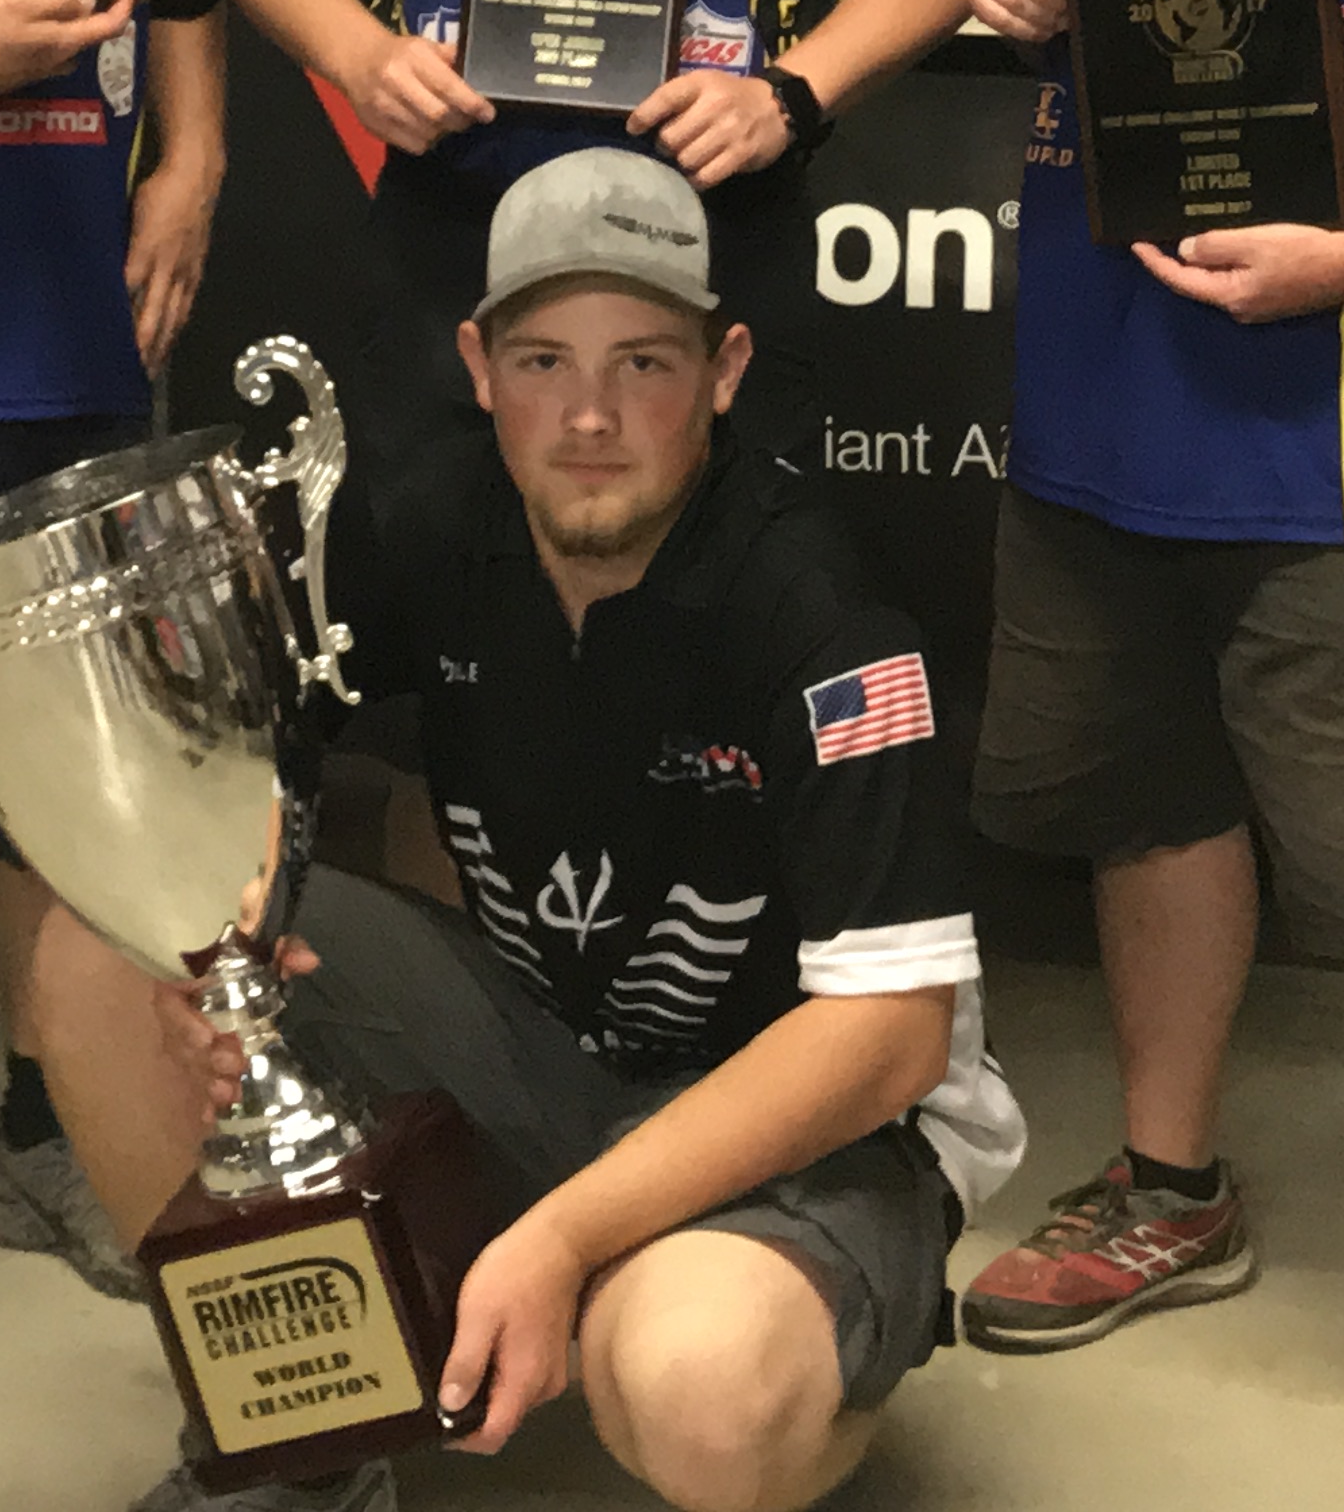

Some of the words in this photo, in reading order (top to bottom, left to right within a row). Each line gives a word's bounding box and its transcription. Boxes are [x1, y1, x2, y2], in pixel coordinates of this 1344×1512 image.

[192, 1269, 341, 1335] RIMFIRE
[205, 1305, 352, 1361] CHALLENGE
[240, 1371, 382, 1420] CHAMPION
[253, 1351, 352, 1388] WORLD
